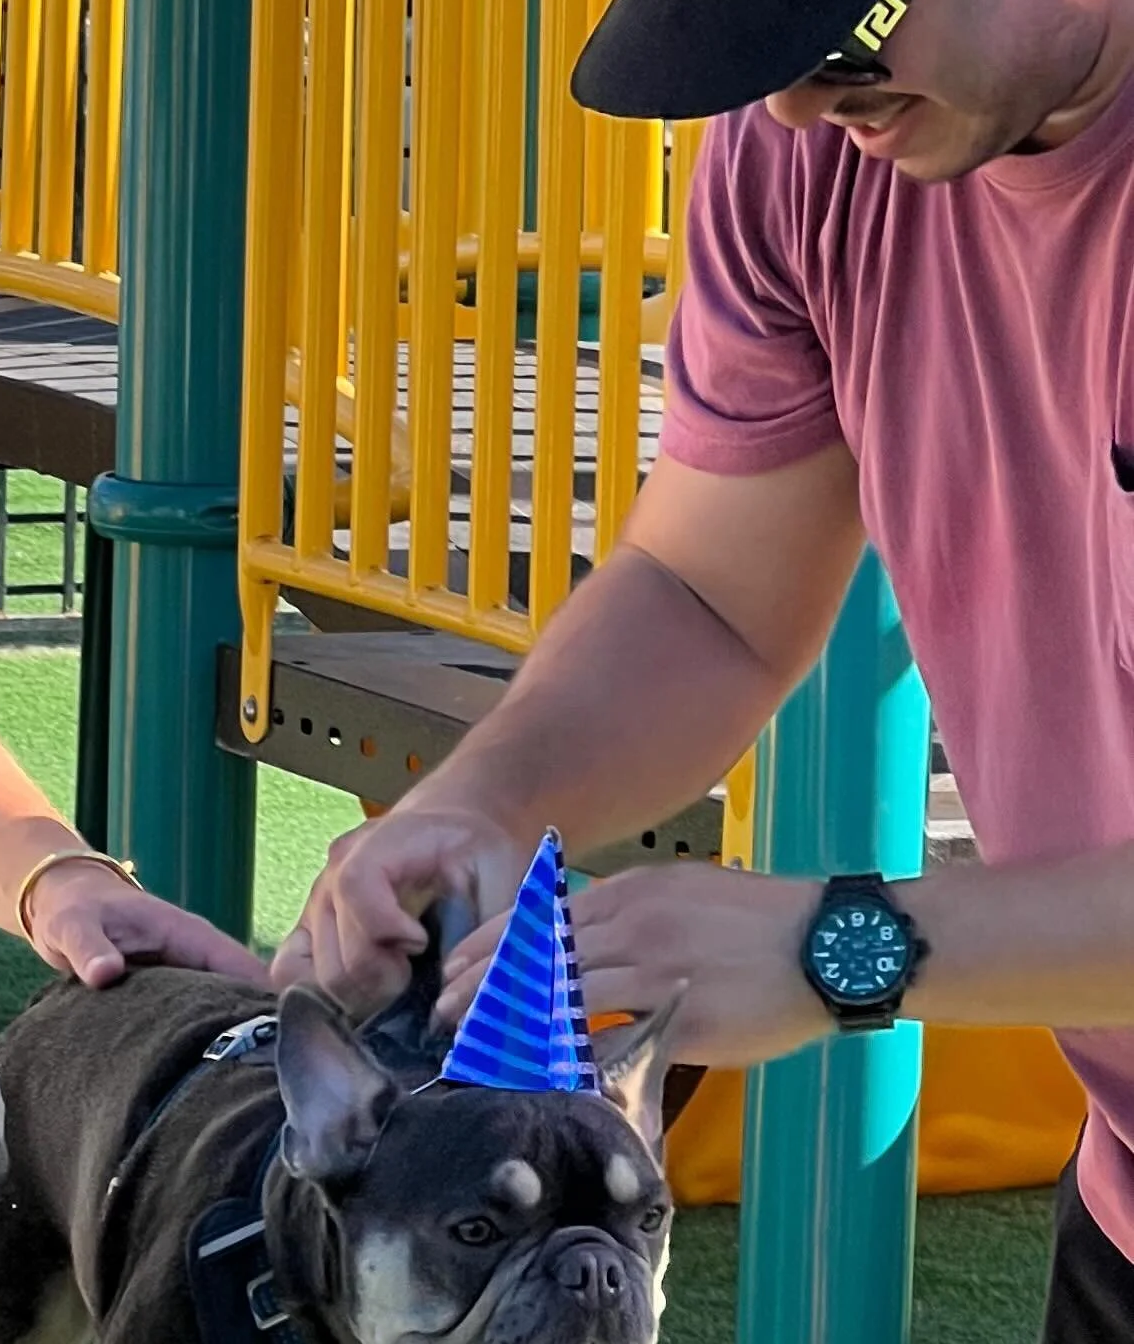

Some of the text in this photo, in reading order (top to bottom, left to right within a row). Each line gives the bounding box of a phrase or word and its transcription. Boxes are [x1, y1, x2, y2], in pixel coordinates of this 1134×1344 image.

[823, 931, 838, 945] 4
[880, 926, 894, 941] 8
[825, 962, 840, 979] 2
